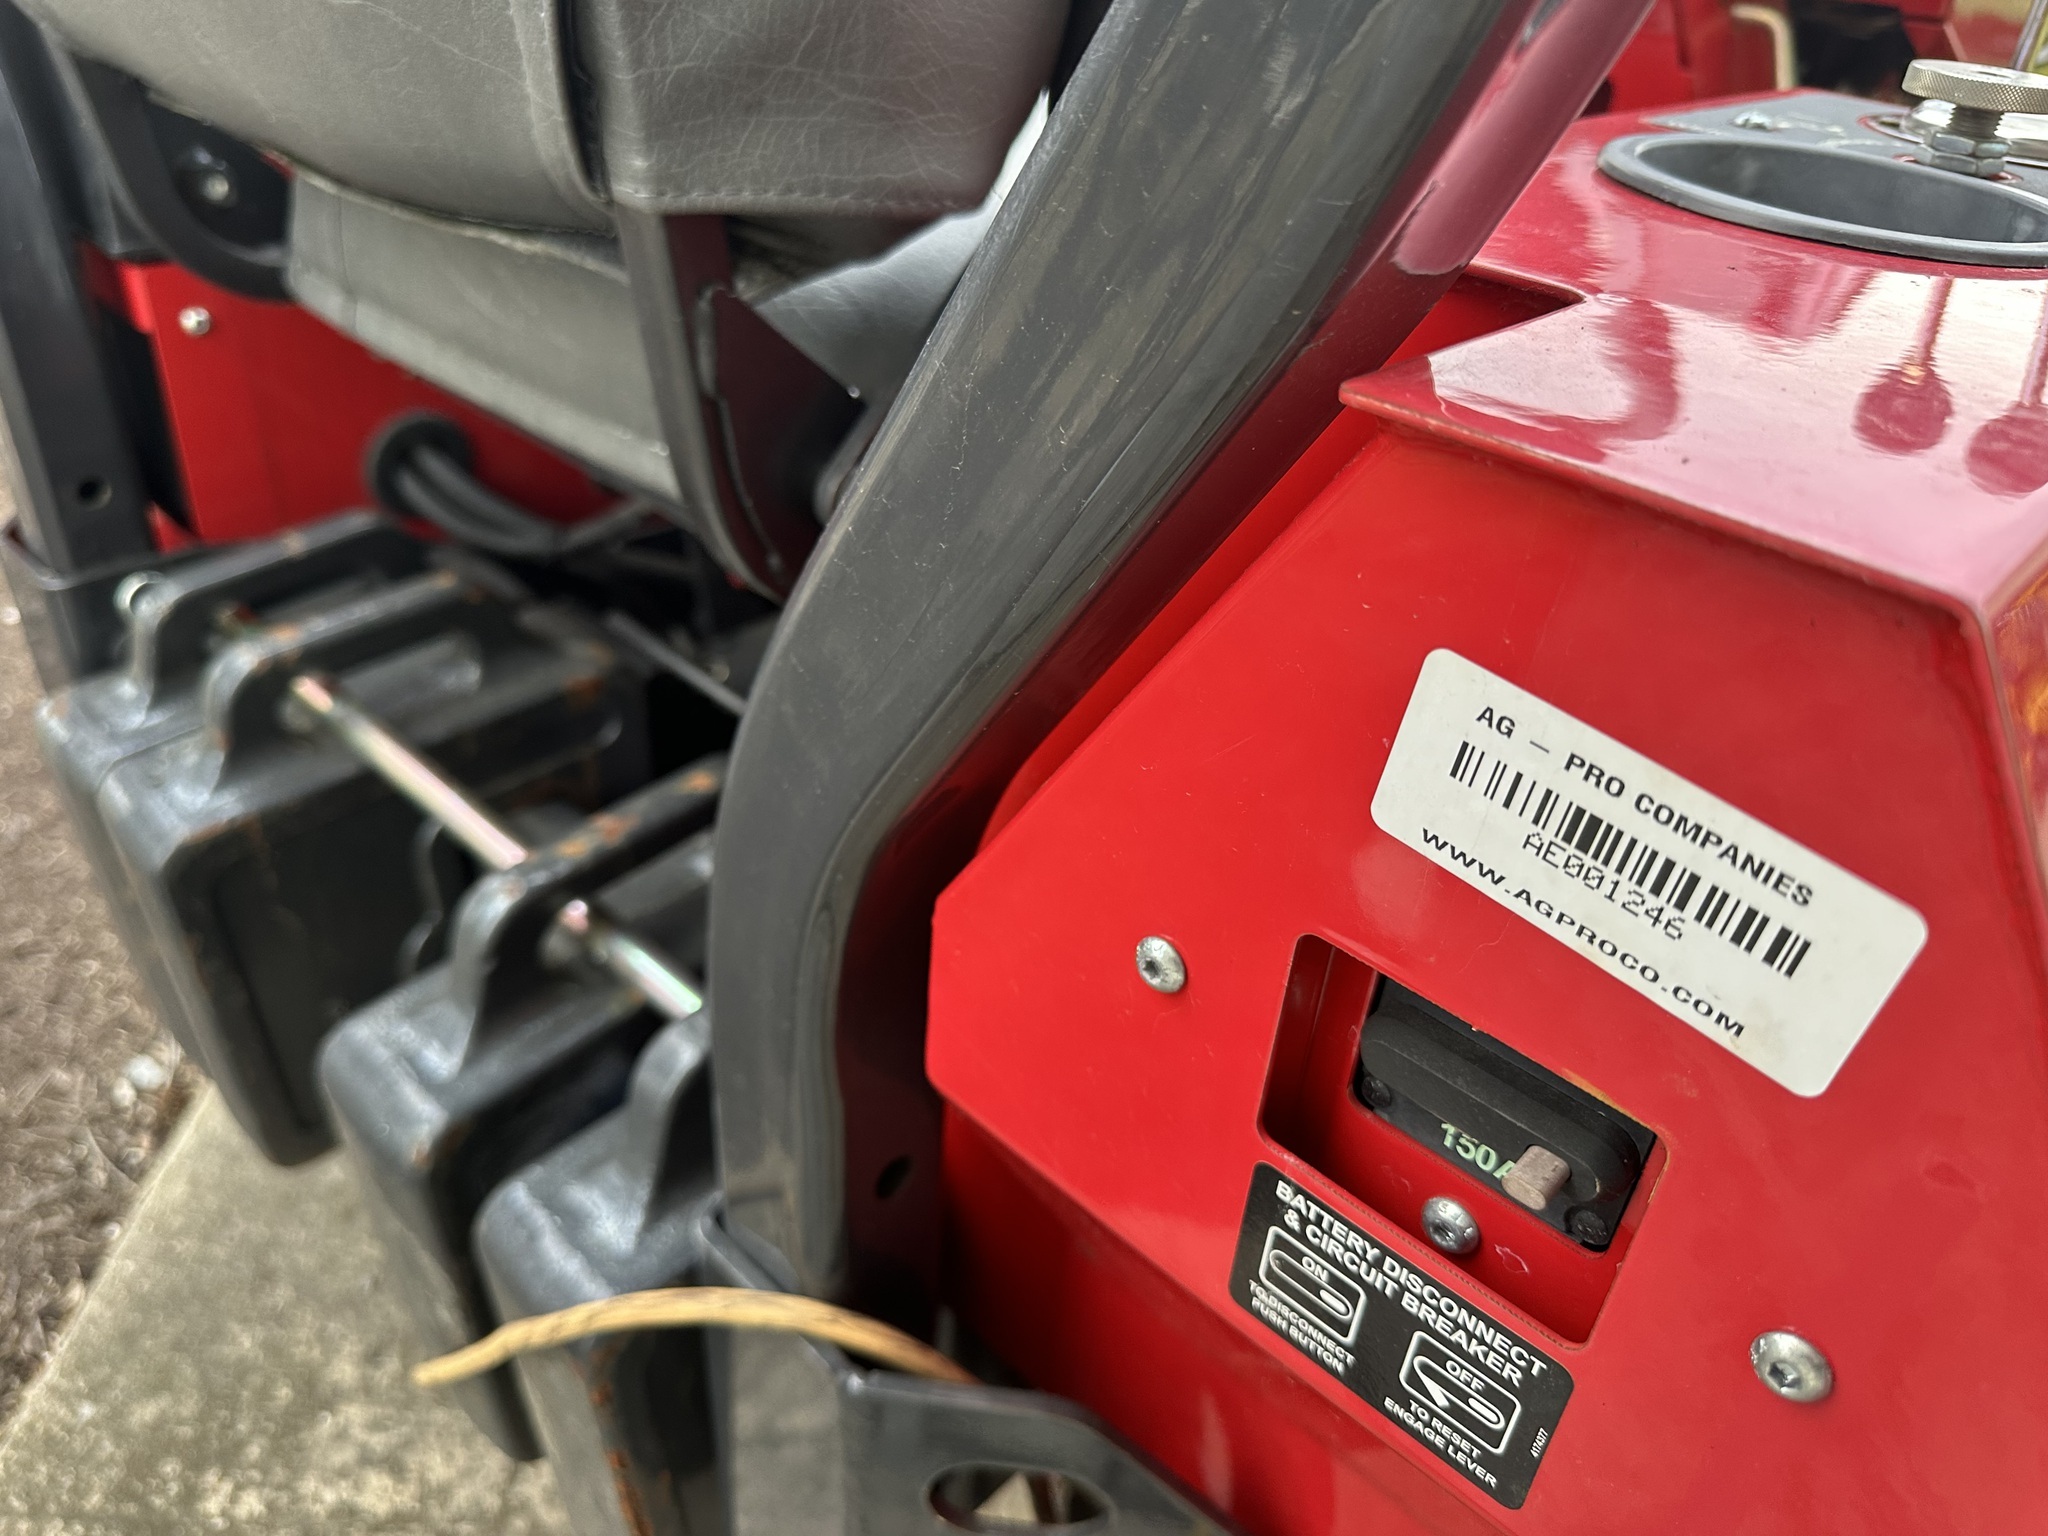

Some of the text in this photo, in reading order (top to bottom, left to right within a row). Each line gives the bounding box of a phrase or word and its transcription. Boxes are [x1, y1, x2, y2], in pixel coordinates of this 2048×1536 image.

[1475, 706, 1516, 738] AG
[1563, 752, 1626, 799] PRO
[1633, 793, 1814, 907] COMPANIES
[1521, 832, 1685, 941] AE001246
[1275, 1180, 1548, 1377] BATTERY DISCONNECT
[1284, 1208, 1523, 1388] & CIRCUIT BREAKER
[1301, 1256, 1329, 1283] ON
[1248, 1279, 1356, 1368] TO DISCONNECT
[1251, 1296, 1345, 1376] PUSH BUTTON
[1445, 1360, 1485, 1392] OFF
[1384, 1396, 1497, 1489] ENGAGE LEVER
[1409, 1399, 1481, 1458] TO RESET
